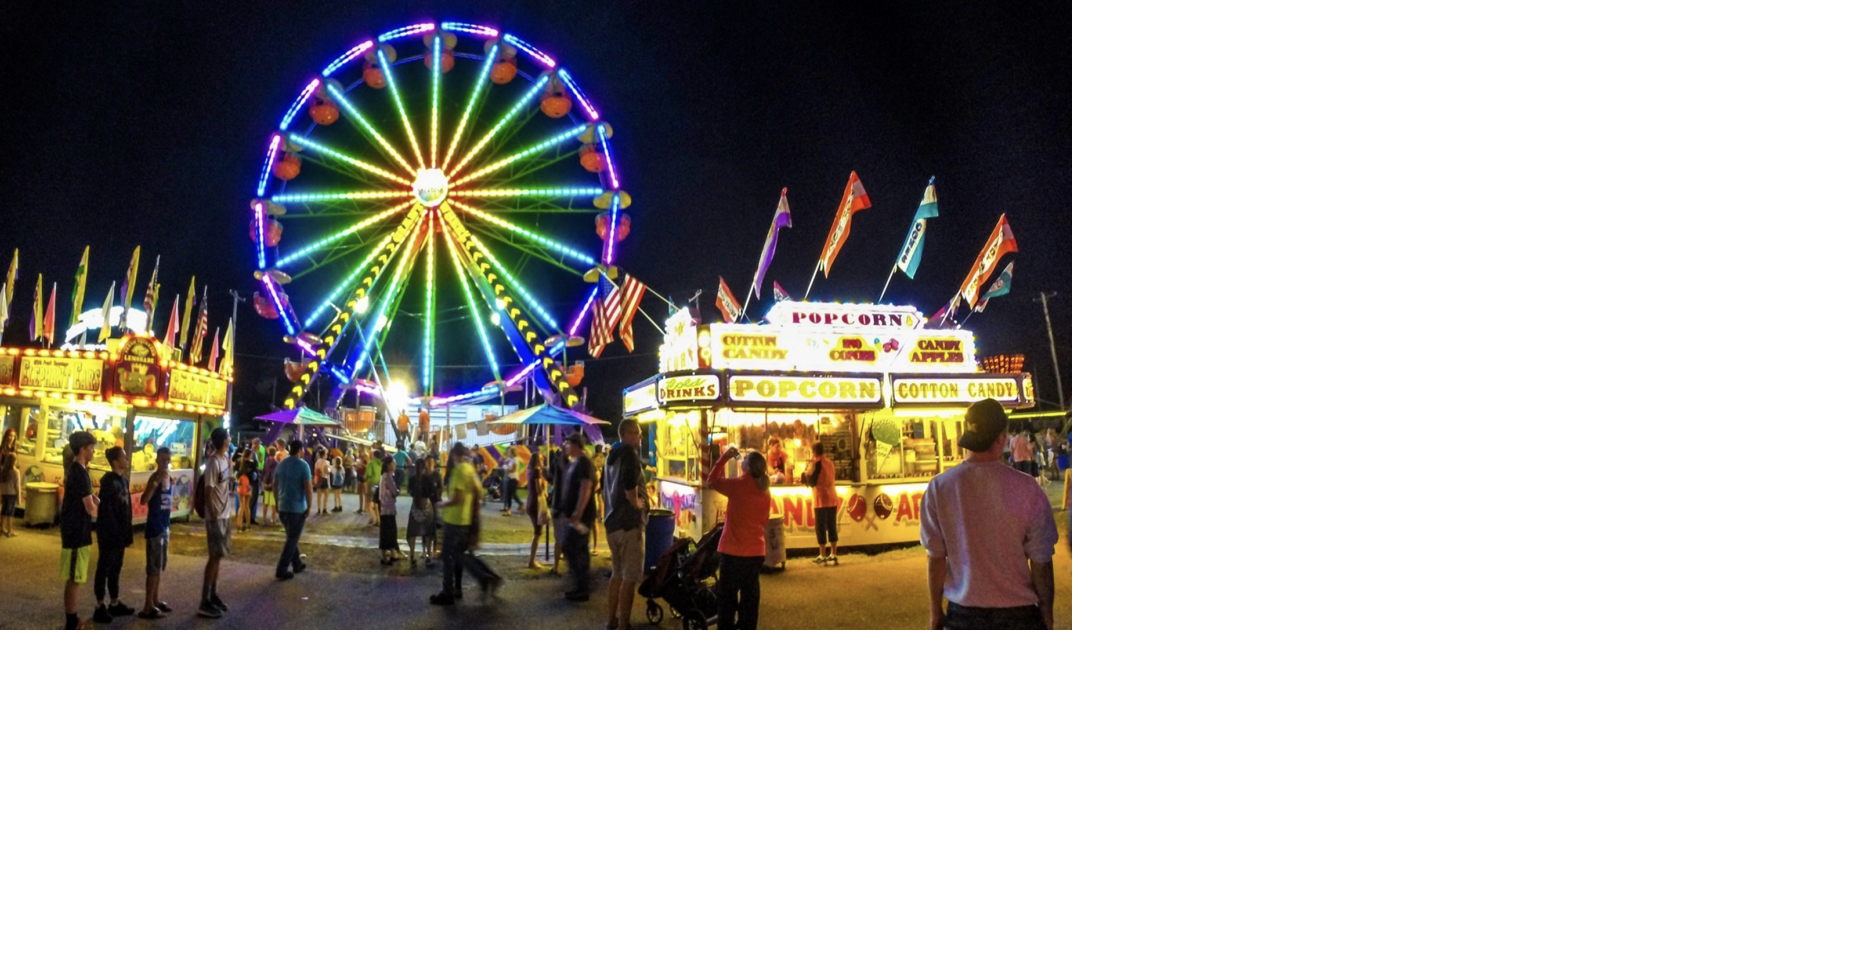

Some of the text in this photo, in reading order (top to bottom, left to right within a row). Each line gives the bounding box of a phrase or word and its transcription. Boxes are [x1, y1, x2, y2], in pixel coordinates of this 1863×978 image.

[792, 312, 902, 326] POPCORN
[722, 335, 777, 347] COTTON
[918, 339, 961, 351] CANDY
[722, 348, 788, 360] CANDY
[911, 352, 964, 363] APPLES
[660, 384, 716, 400] DRINKS
[734, 379, 876, 398] POPCORN
[898, 382, 959, 399] COTTON
[967, 382, 1013, 398] CANDY
